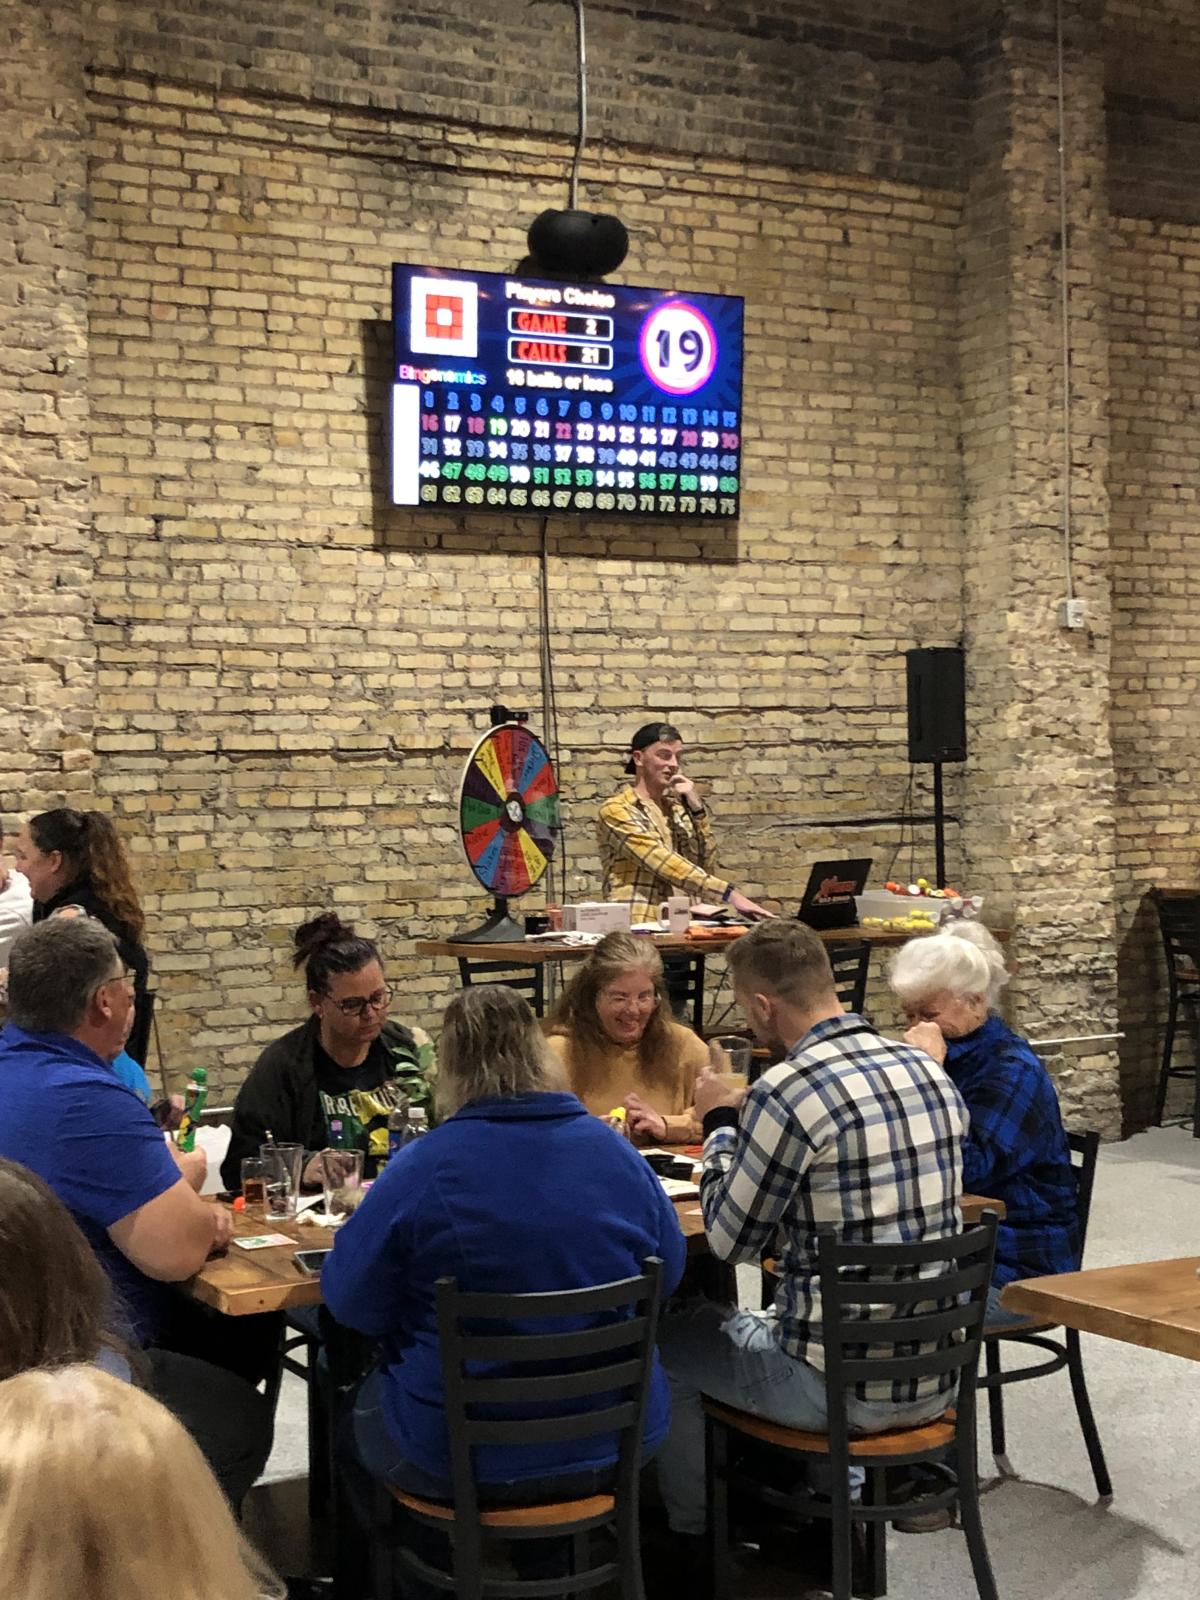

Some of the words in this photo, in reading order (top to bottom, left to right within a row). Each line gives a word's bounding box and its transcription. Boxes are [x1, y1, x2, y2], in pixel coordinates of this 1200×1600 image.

[517, 312, 567, 334] GAME
[585, 318, 597, 335] 2
[517, 341, 567, 363] CALLS
[581, 347, 599, 364] 21
[656, 329, 703, 372] 19
[564, 375, 582, 390] or
[424, 391, 434, 407] 1
[448, 392, 459, 410] 2
[471, 393, 481, 411] 3
[491, 395, 504, 412] 4
[515, 397, 526, 414] 5
[536, 398, 548, 415] 6
[558, 400, 570, 416] 7
[579, 402, 592, 418] 8
[601, 403, 613, 420] 9
[619, 404, 637, 421] 10
[642, 406, 655, 422] 11
[662, 407, 676, 424] 12
[682, 408, 697, 425] 13
[703, 410, 718, 426] 14
[723, 411, 736, 427] 15
[490, 418, 507, 435] 19
[535, 421, 550, 438] 21
[577, 423, 594, 440] 23
[598, 425, 615, 442] 24
[619, 426, 635, 443] 25
[661, 429, 677, 445] 27
[682, 430, 697, 447] 28
[702, 431, 718, 448] 29
[422, 437, 437, 455] 31
[443, 439, 461, 456] 32
[466, 440, 484, 457] 33
[488, 441, 507, 458] 34
[511, 443, 527, 460] 35
[533, 444, 550, 461] 36
[555, 444, 571, 462] 37
[576, 447, 595, 463] 38
[598, 448, 615, 464] 39
[617, 449, 638, 466] 40
[639, 451, 656, 467] 41
[659, 452, 677, 468] 42
[680, 453, 697, 469] 43
[700, 454, 718, 470] 44
[720, 455, 737, 471] 45
[420, 461, 440, 478] 46
[442, 462, 462, 479] 47
[465, 464, 486, 481] 48
[487, 465, 508, 482] 49
[533, 467, 549, 484] 51
[555, 468, 571, 485] 52
[576, 469, 593, 486] 53
[596, 470, 615, 487] 54
[618, 472, 634, 488] 55
[639, 473, 656, 489] 56
[660, 474, 676, 490] 57
[680, 475, 697, 491] 58
[700, 476, 718, 492] 59
[720, 476, 737, 493] 60
[421, 485, 437, 502] 61
[443, 486, 461, 502] 62
[465, 487, 484, 504] 63
[487, 488, 506, 504] 64
[510, 489, 527, 506] 65
[531, 490, 550, 507] 66
[553, 491, 571, 507] 67
[574, 492, 594, 508] 68
[596, 493, 615, 510] 69
[617, 494, 636, 510] 70
[639, 495, 654, 511] 71
[659, 496, 675, 512] 72
[680, 497, 696, 513] 73
[700, 498, 716, 513] 74
[720, 498, 735, 514] 75
